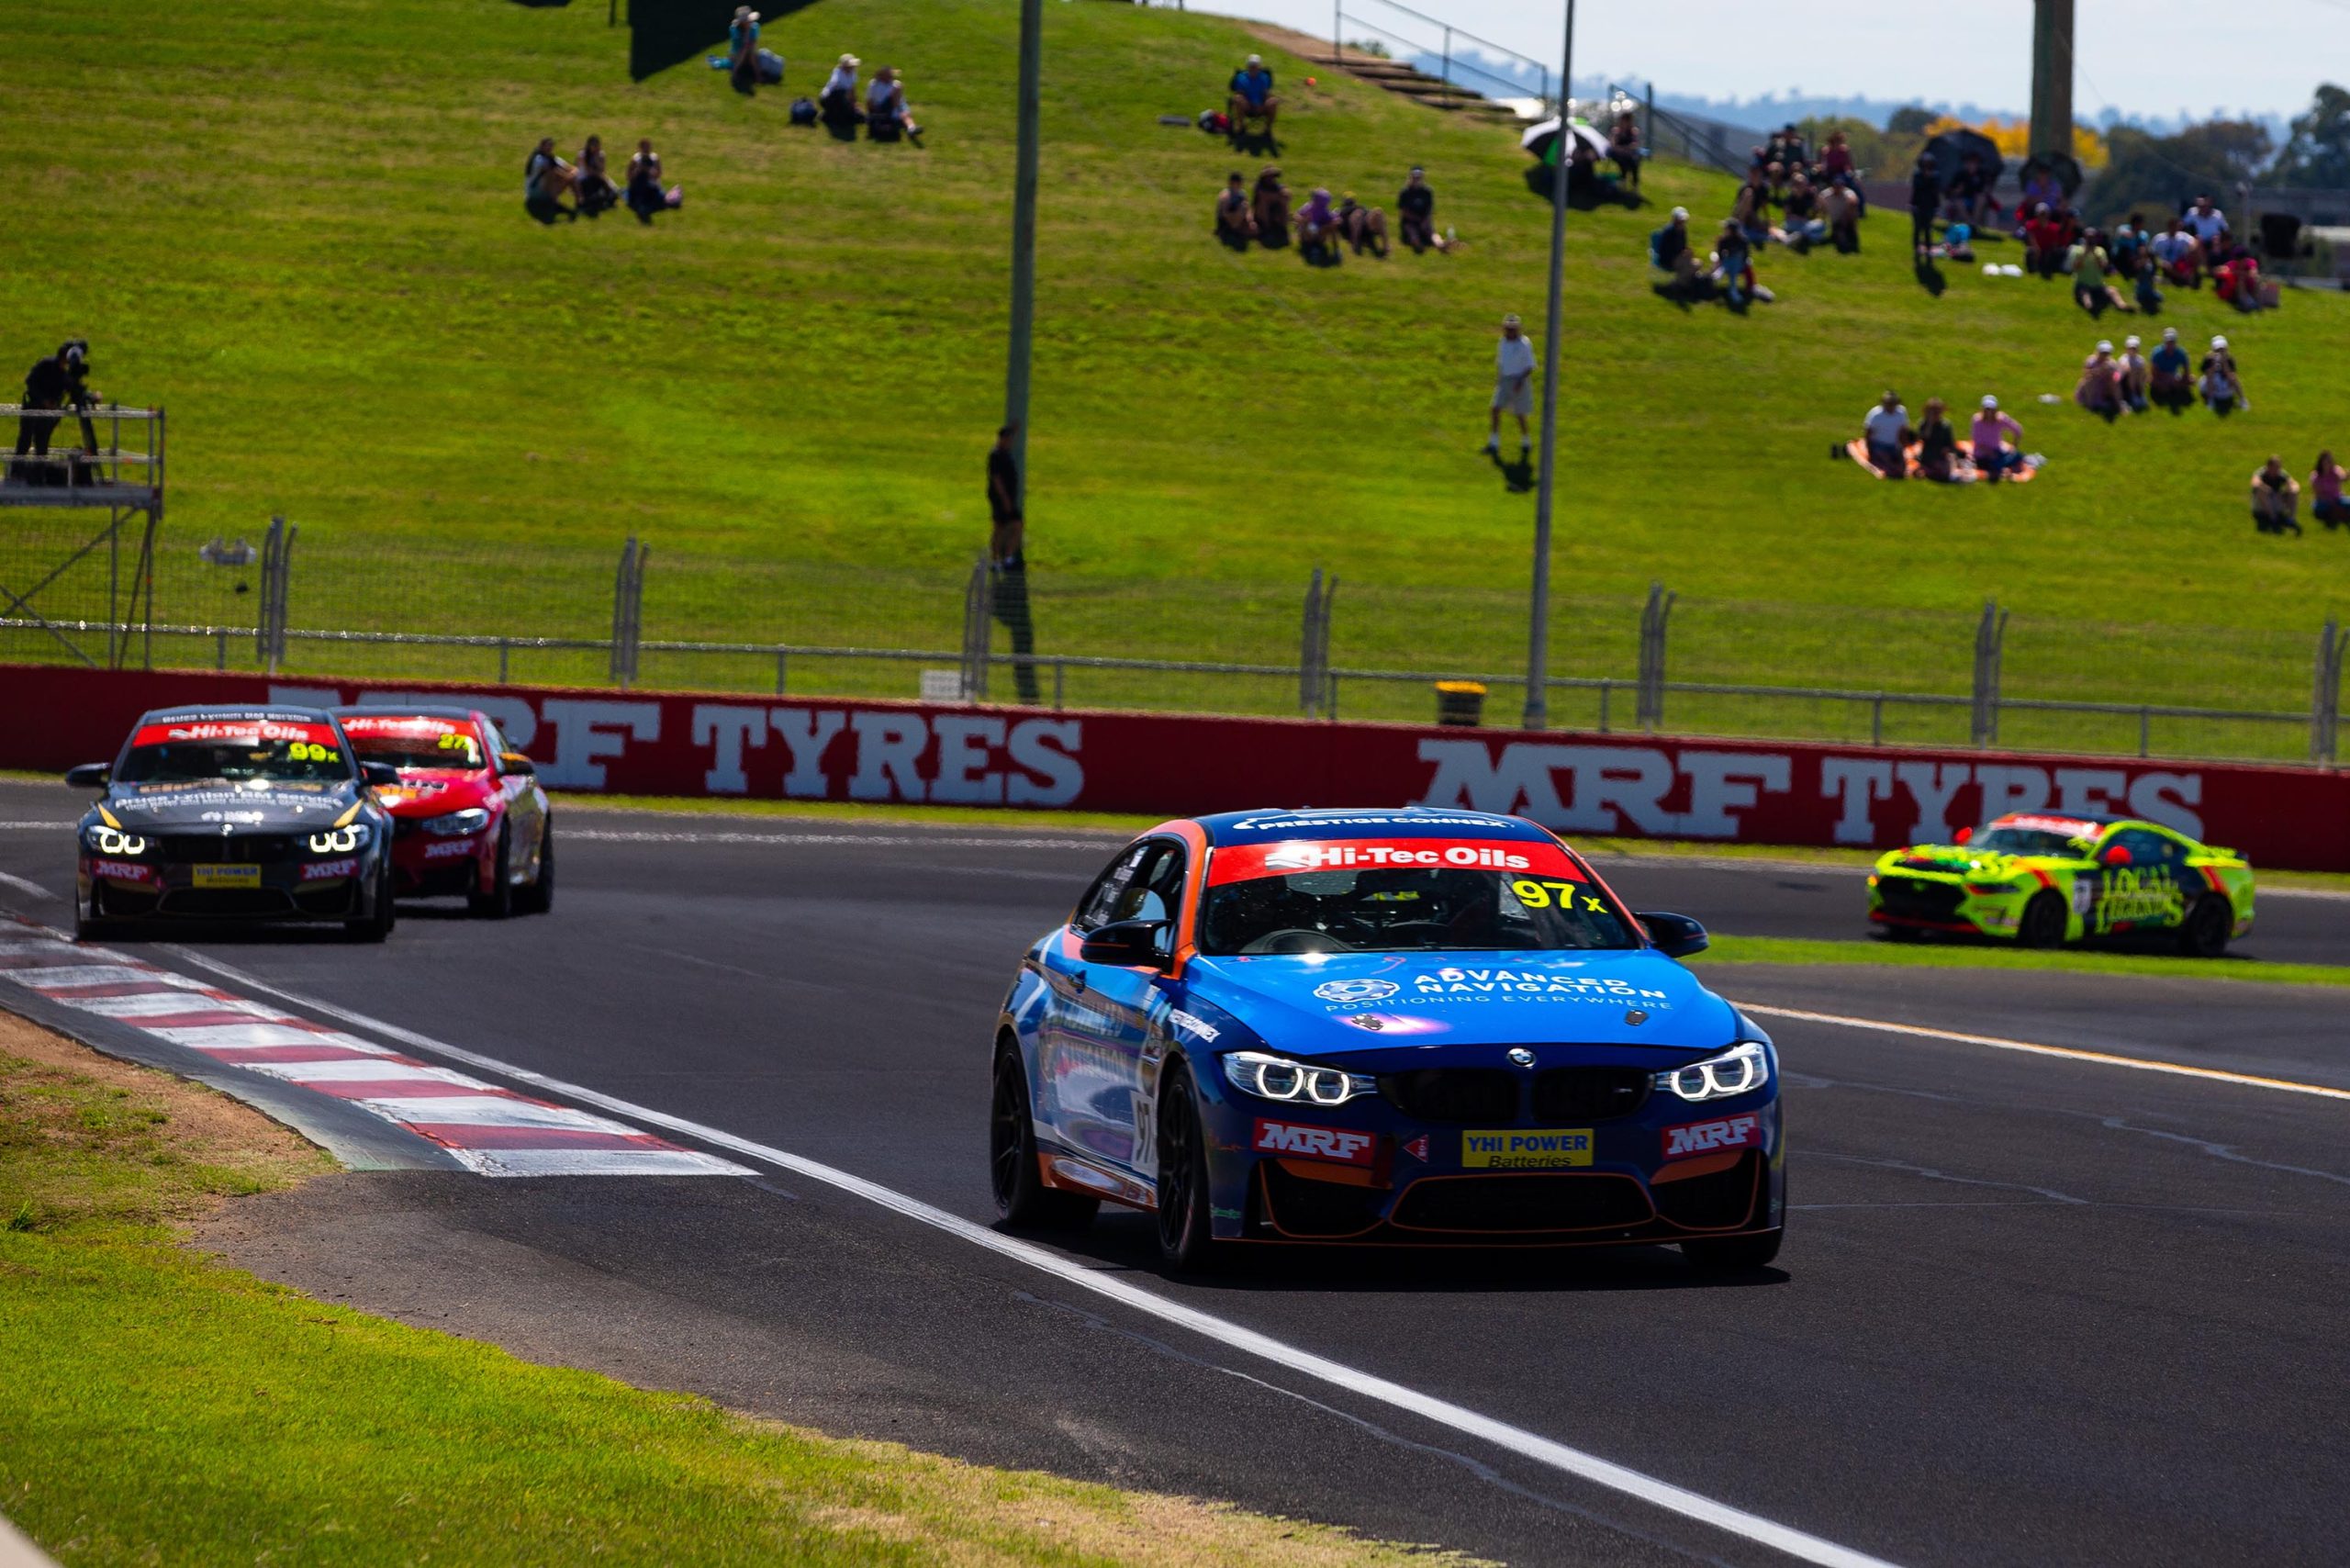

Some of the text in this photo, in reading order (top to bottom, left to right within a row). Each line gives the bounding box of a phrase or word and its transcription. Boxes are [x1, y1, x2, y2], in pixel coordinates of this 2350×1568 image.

[189, 723, 309, 741] Hi-Tec Oils
[693, 703, 1084, 806] TYRES
[1418, 737, 1792, 837] MRF
[1258, 817, 1508, 830] PRESTIGE CONNEX
[424, 839, 476, 857] MRF
[1310, 846, 1530, 869] Hi-Tec Oils
[95, 859, 148, 879] MRF
[305, 859, 357, 879] MRF
[1414, 967, 1628, 987] ADVANCED
[1416, 982, 1667, 999] NAVIGATION
[1325, 994, 1674, 1013] POSITIONING EVERYWHERE
[1258, 1122, 1371, 1159] MRF
[1467, 1135, 1589, 1153] YHI POWER
[1667, 1116, 1755, 1155] MRF
[1487, 1155, 1572, 1169] Batteries
